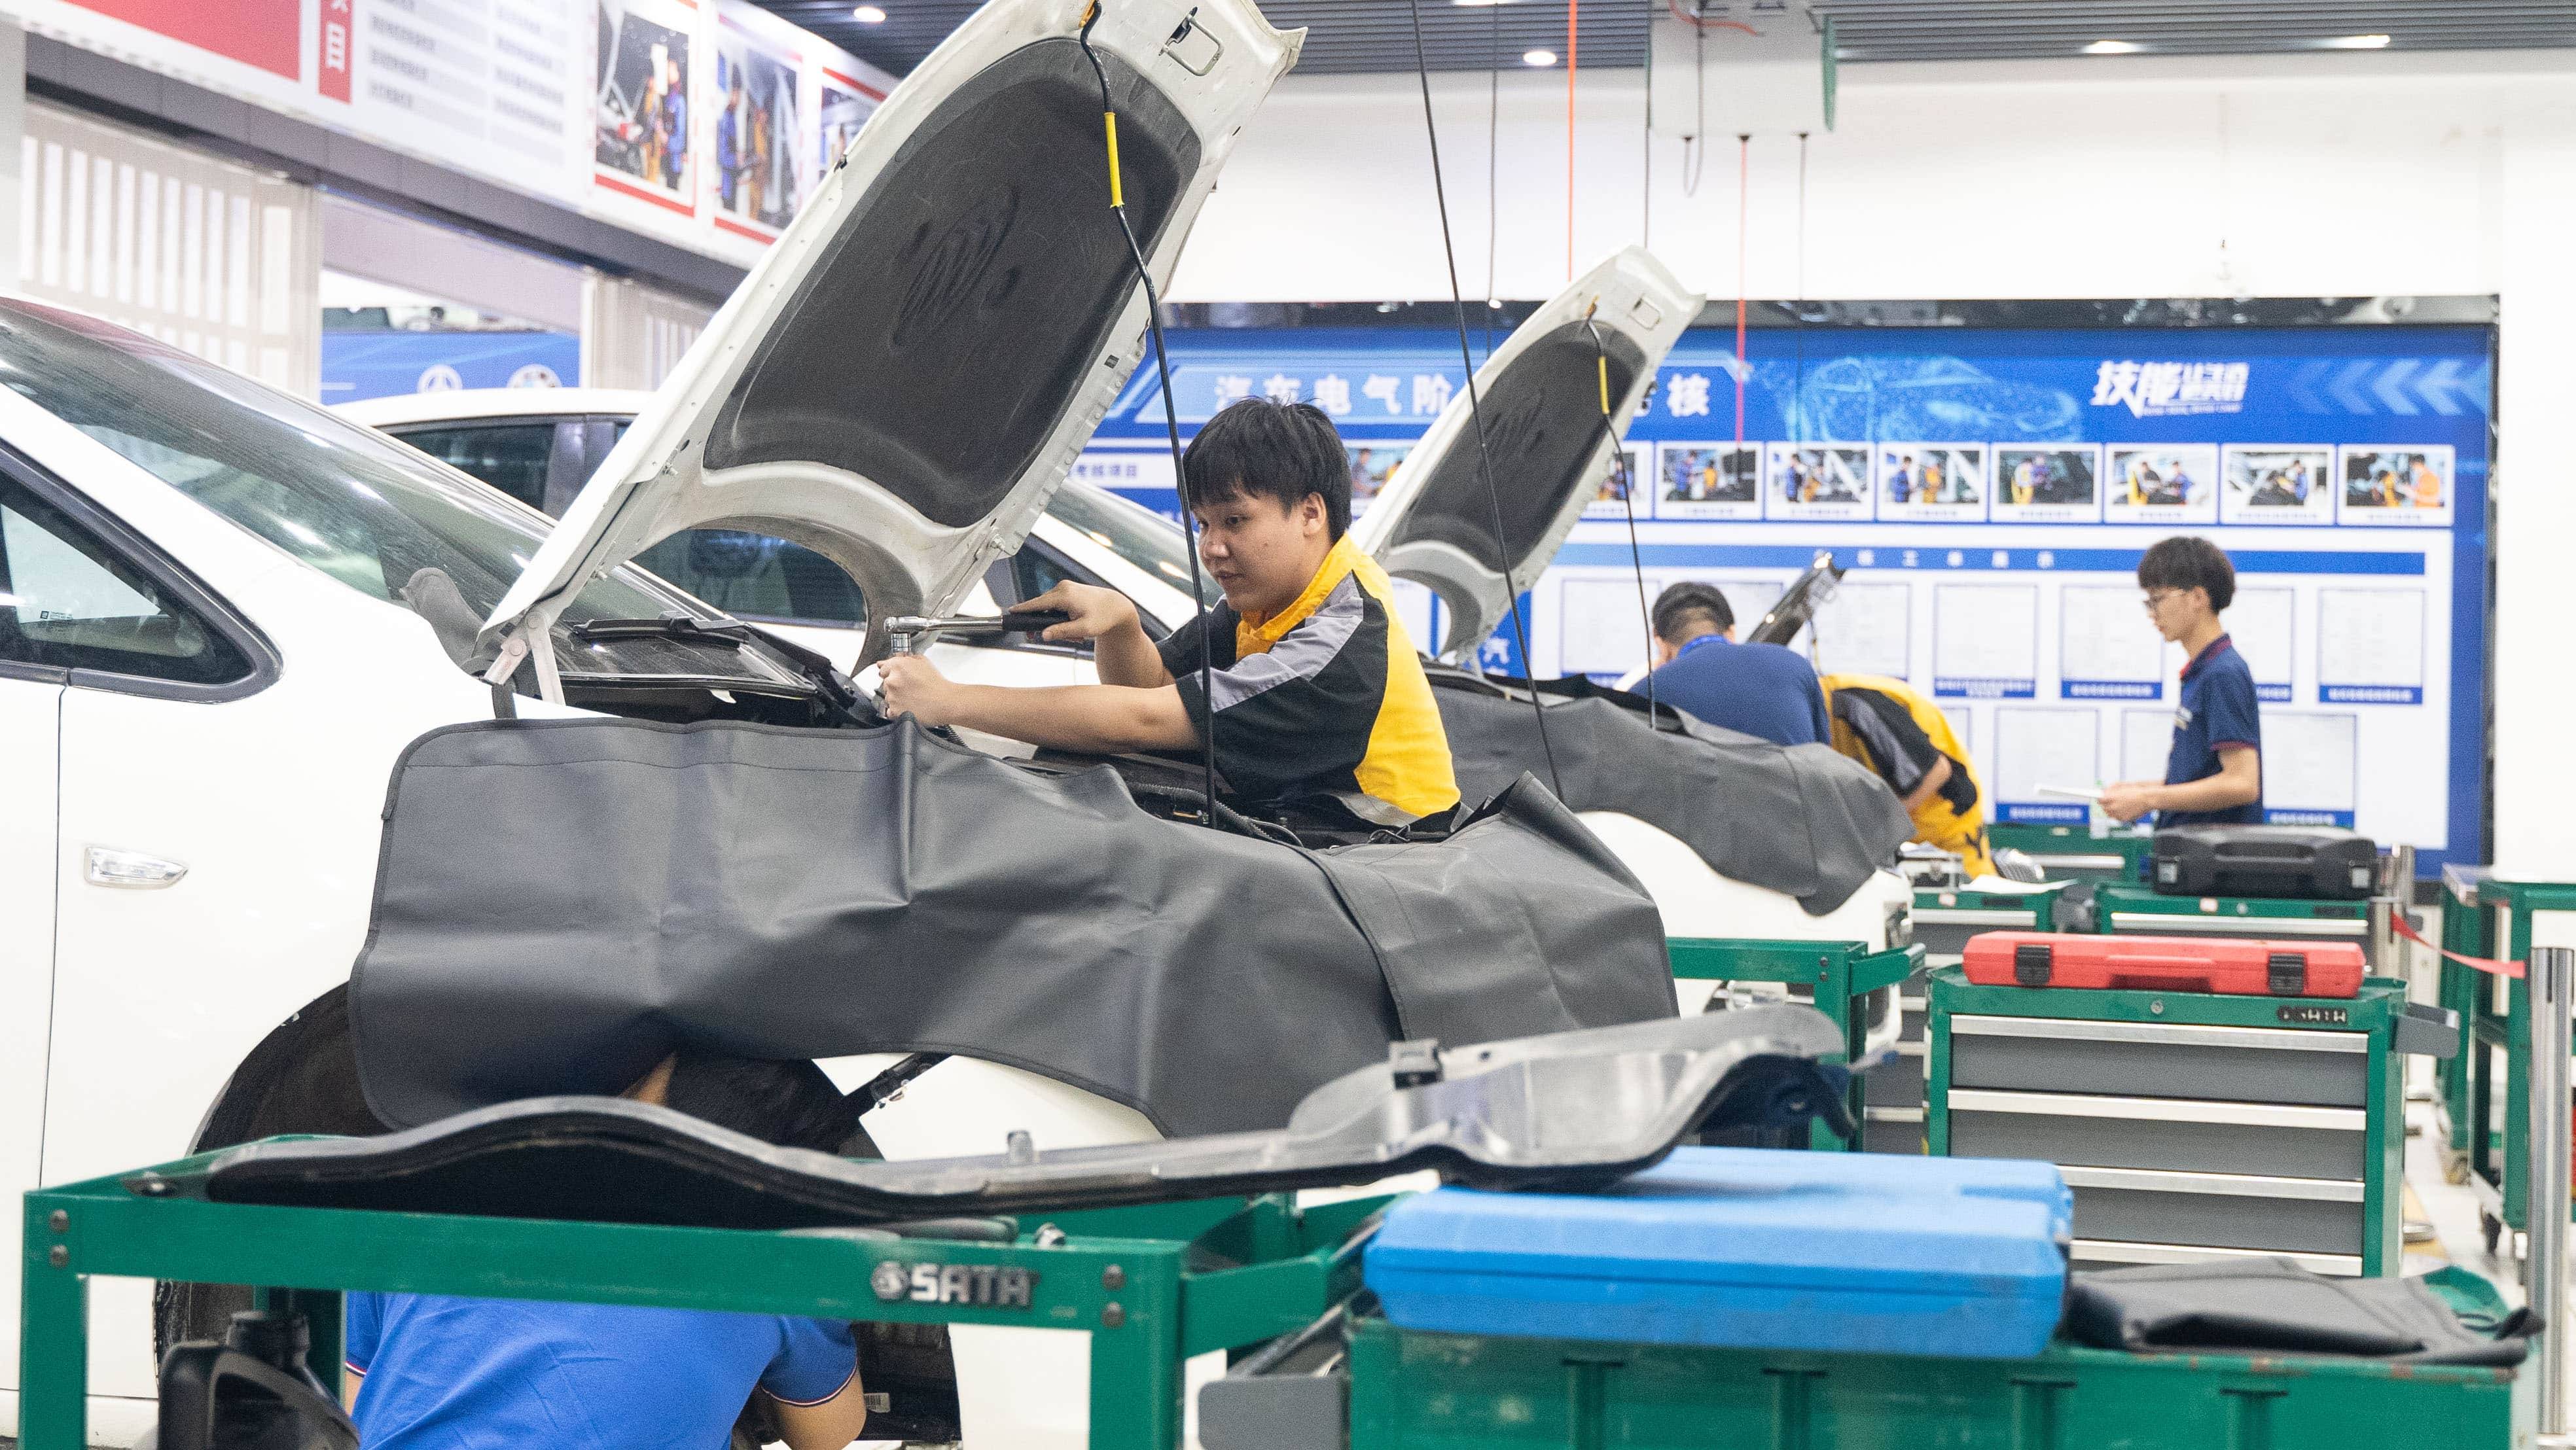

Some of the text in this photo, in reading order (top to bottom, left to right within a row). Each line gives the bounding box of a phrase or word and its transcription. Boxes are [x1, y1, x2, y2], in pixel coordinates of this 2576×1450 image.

[2090, 360, 2184, 418] 技能
[1067, 464, 1137, 478] 考核项目
[910, 1263, 1031, 1306] SATA
